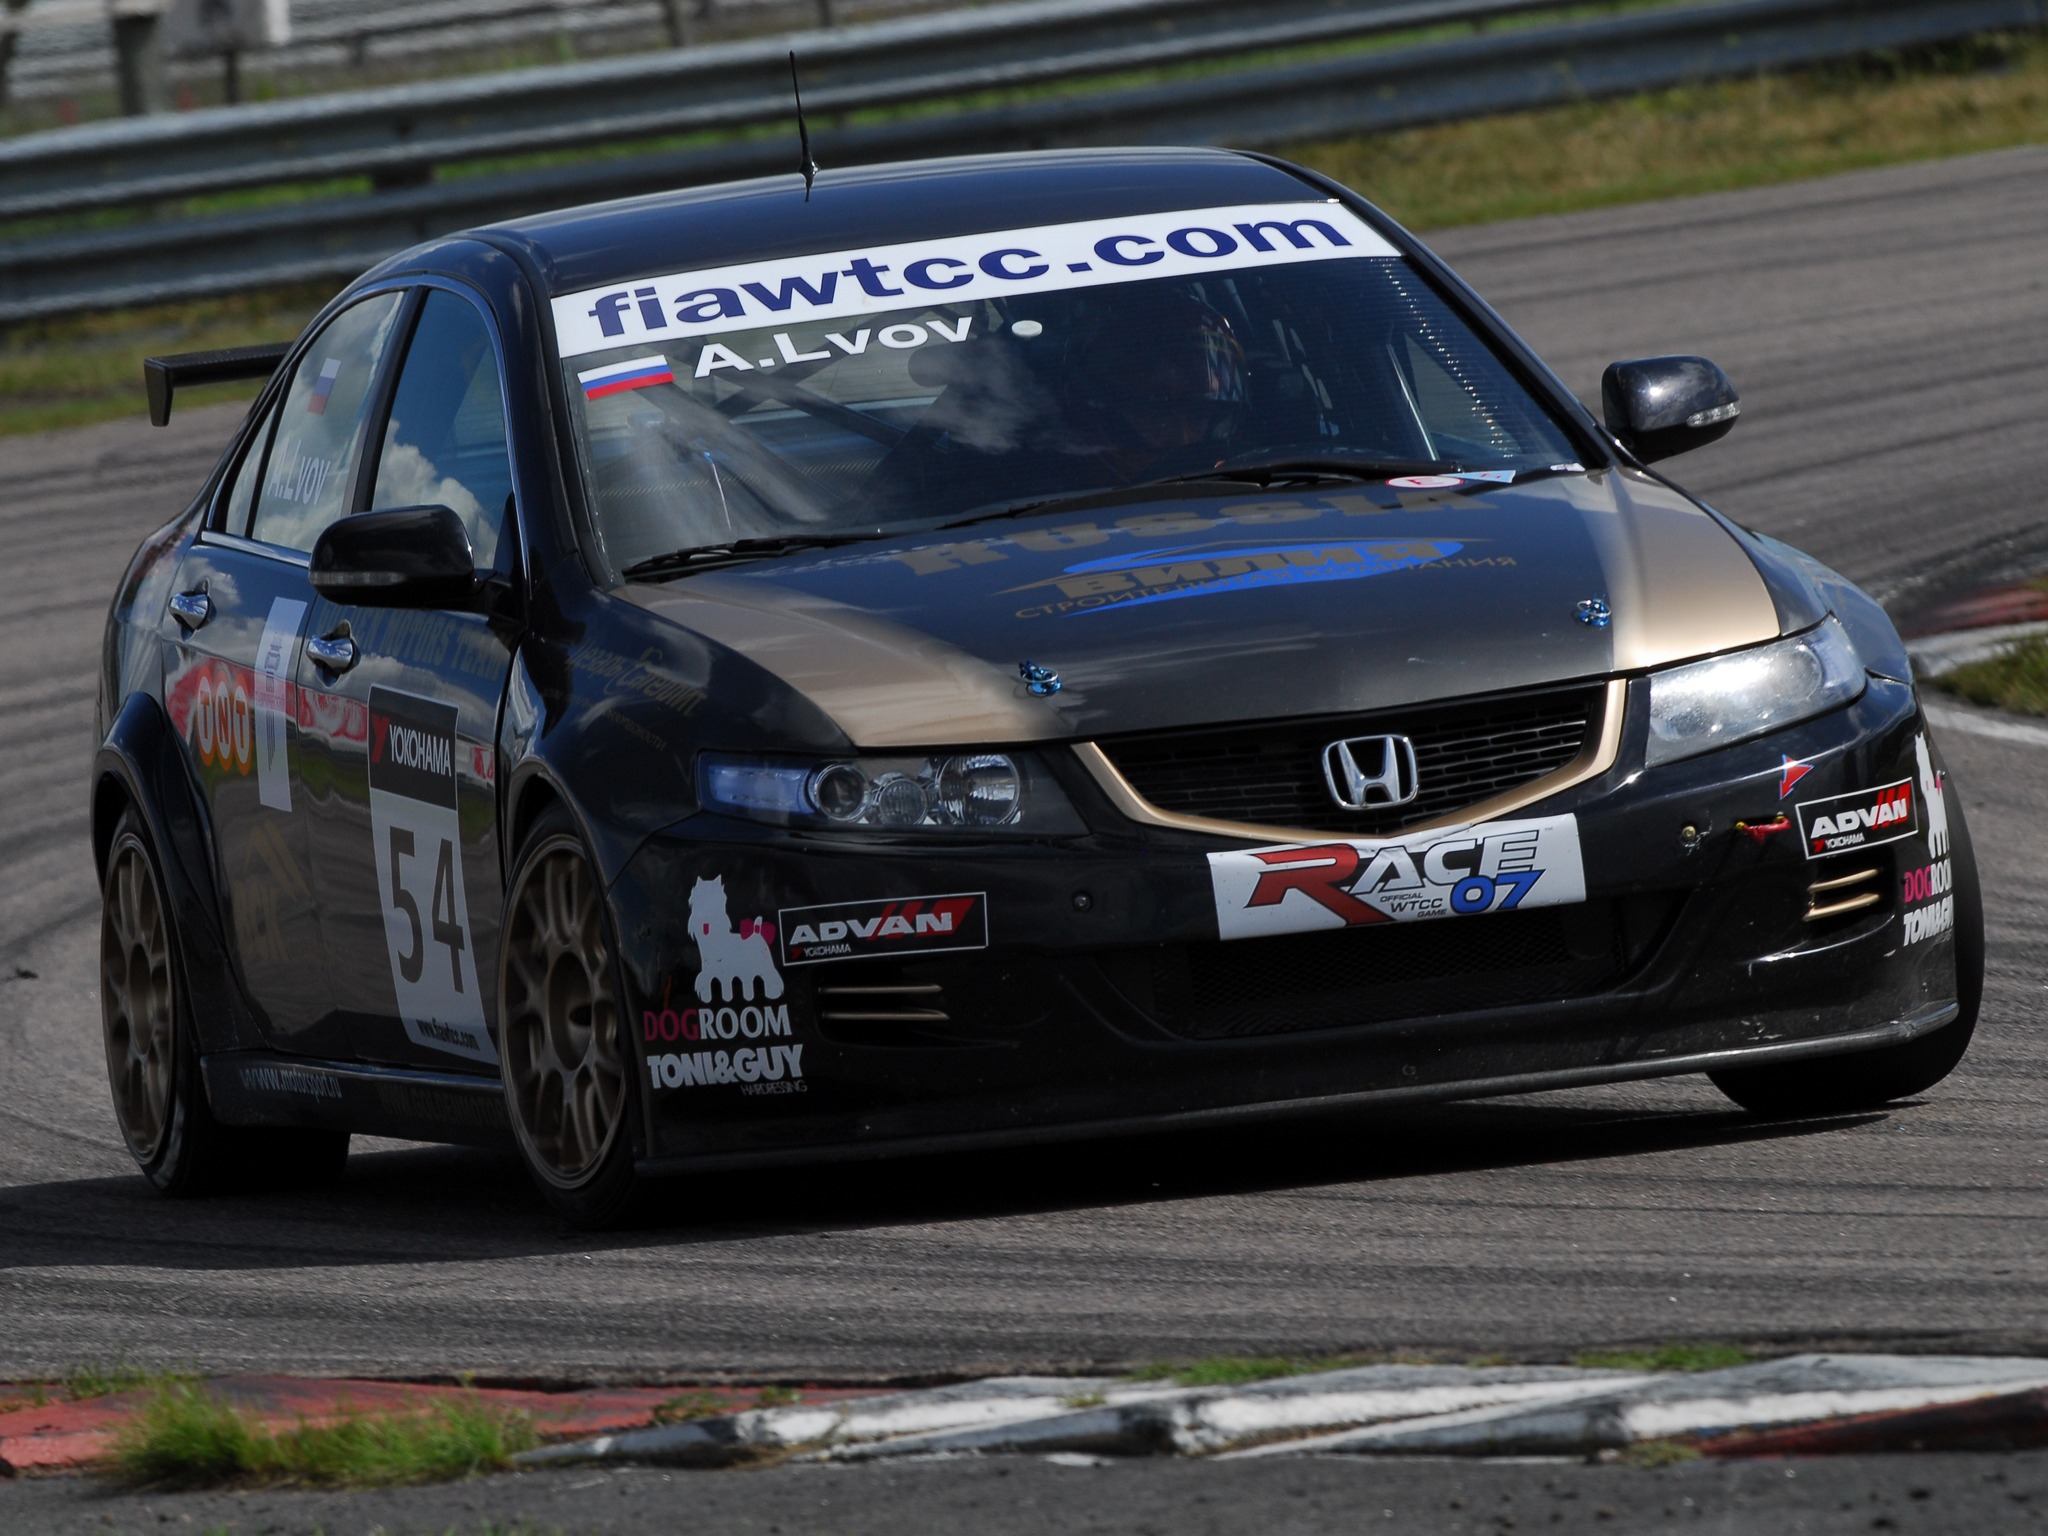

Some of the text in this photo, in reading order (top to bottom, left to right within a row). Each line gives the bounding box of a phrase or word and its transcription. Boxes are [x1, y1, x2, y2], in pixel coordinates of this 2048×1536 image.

[588, 217, 1352, 338] fiawtcc.com
[693, 315, 973, 379] A.Lvov
[1056, 541, 1446, 599] ВИЛИЯ
[379, 609, 457, 667] MOTORS
[389, 724, 452, 777] YOKOHAMA
[1810, 798, 1908, 839] ADVAN
[1825, 832, 1865, 850] YOKOHAMA
[1243, 829, 1540, 927] RACE
[1380, 892, 1424, 903] OFFICIAL
[1449, 868, 1546, 915] 07
[389, 825, 465, 994] 54
[1391, 898, 1443, 913] WTCC
[1417, 908, 1448, 918] GAME
[790, 912, 953, 946] ADVAN
[803, 943, 852, 957] YOKOHAMA
[643, 1004, 793, 1041] DOGROOM
[647, 1044, 804, 1089] TONI&GUY
